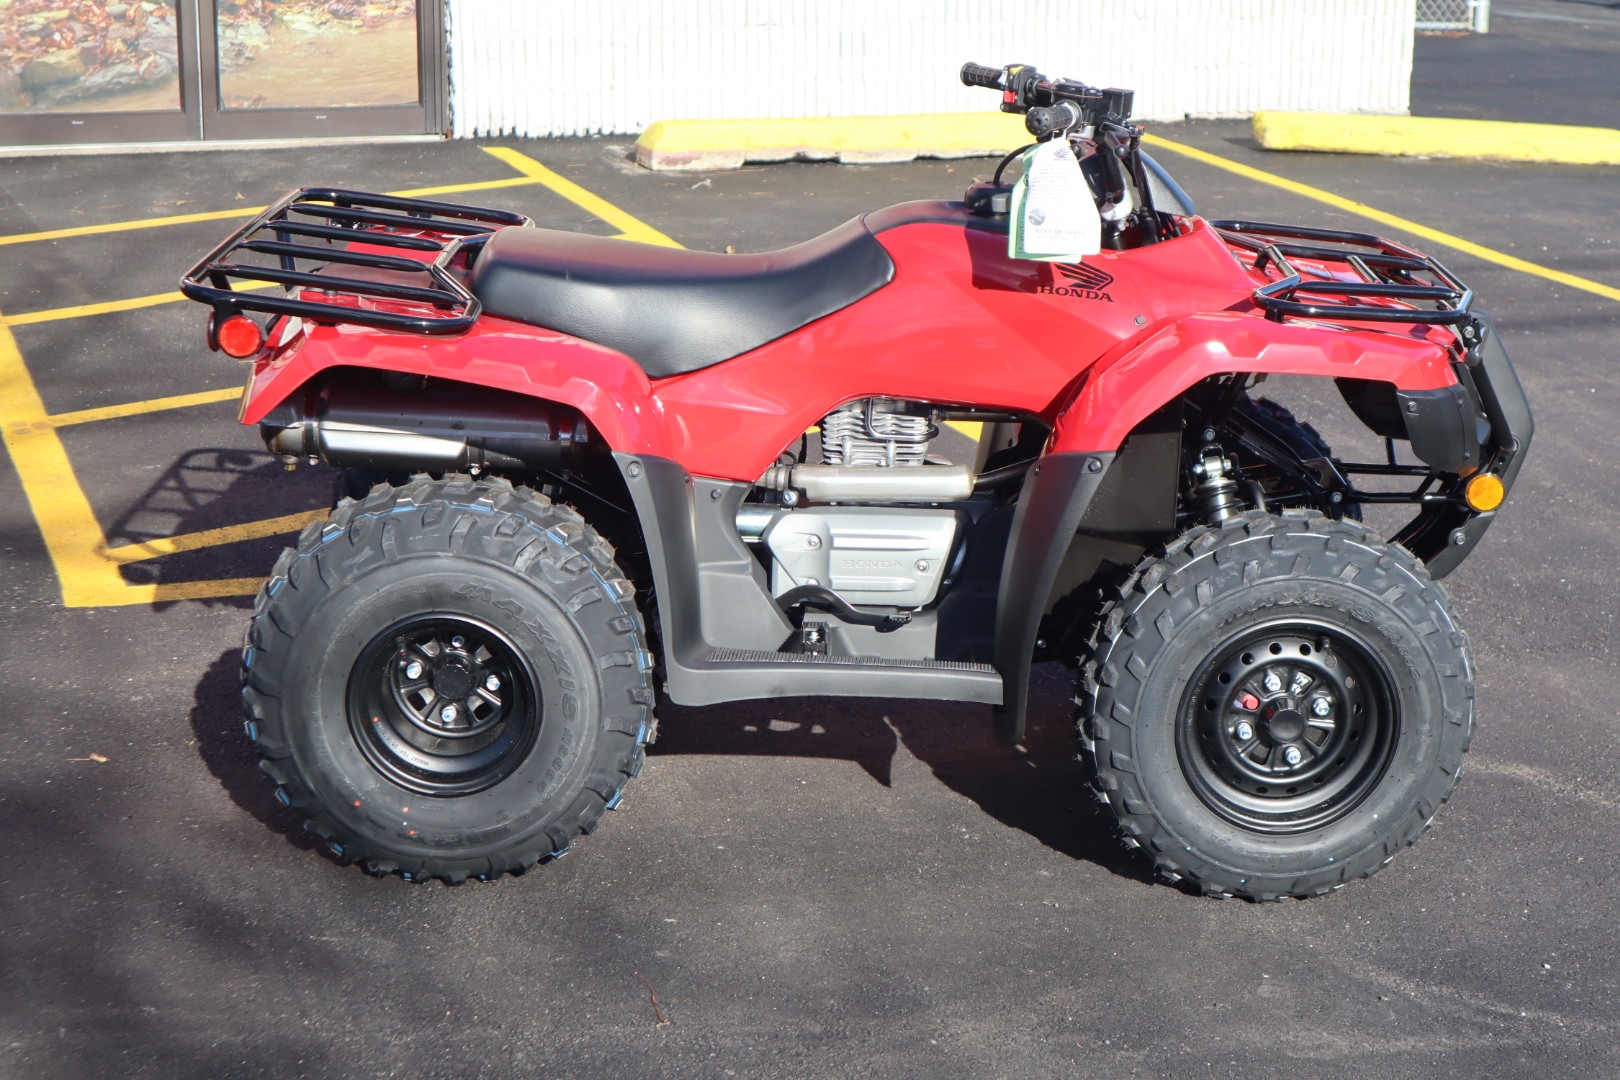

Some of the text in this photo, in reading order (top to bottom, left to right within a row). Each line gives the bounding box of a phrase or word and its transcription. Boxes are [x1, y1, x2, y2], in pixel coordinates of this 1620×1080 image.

[1037, 284, 1114, 302] HONDA
[841, 560, 904, 568] HONDA
[1217, 590, 1375, 628] MAXXIS
[456, 583, 579, 720] MAXXIS
